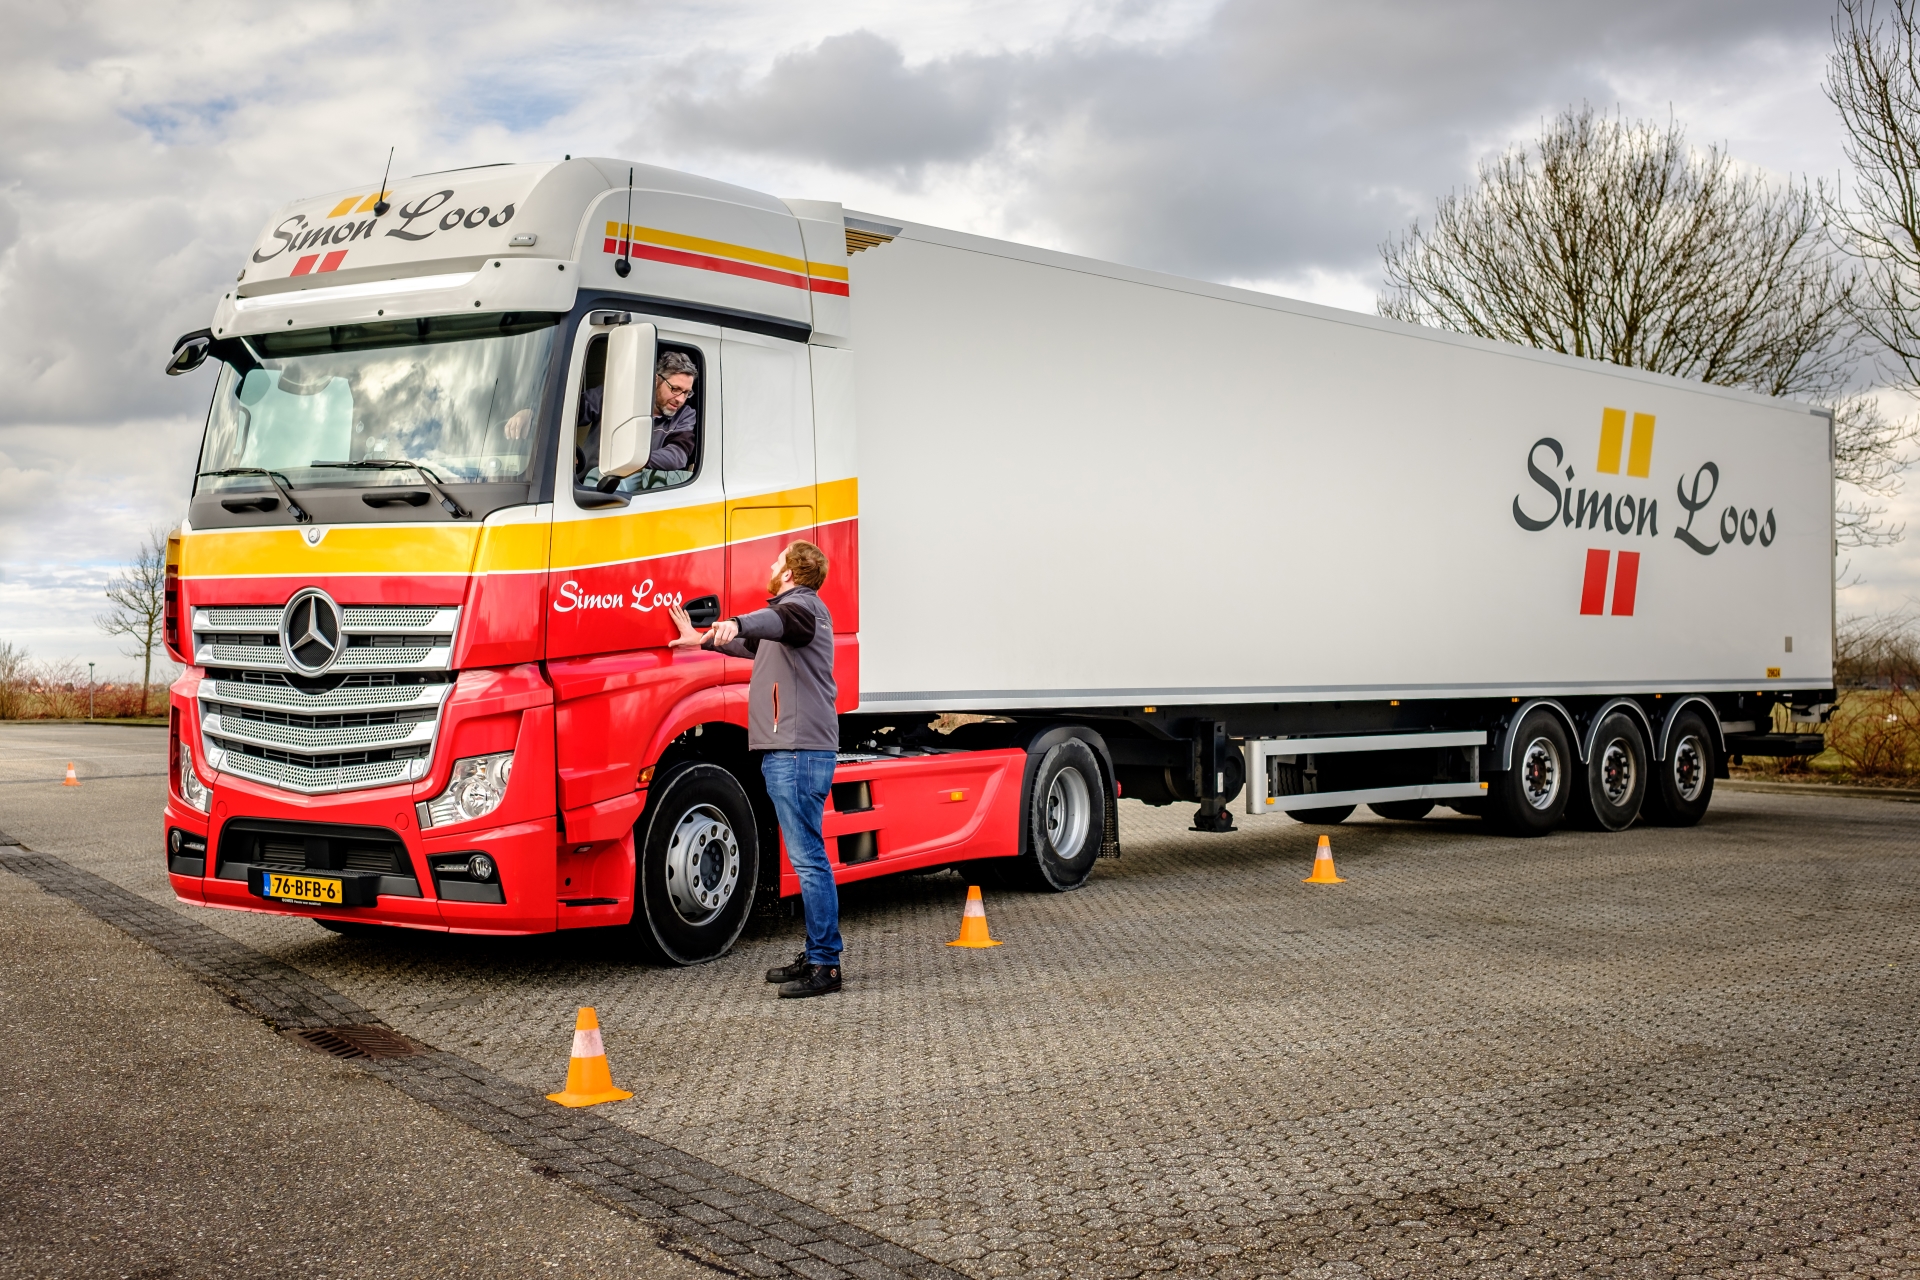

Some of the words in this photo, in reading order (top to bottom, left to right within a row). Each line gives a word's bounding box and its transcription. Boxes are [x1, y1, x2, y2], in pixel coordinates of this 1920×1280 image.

[252, 214, 378, 263] Simon
[384, 189, 515, 241] Loos
[1512, 437, 1659, 538] Simon
[1673, 461, 1777, 556] Loos
[553, 580, 624, 612] Simon
[630, 578, 683, 612] Loos
[274, 877, 336, 899] 76-BFB-6
